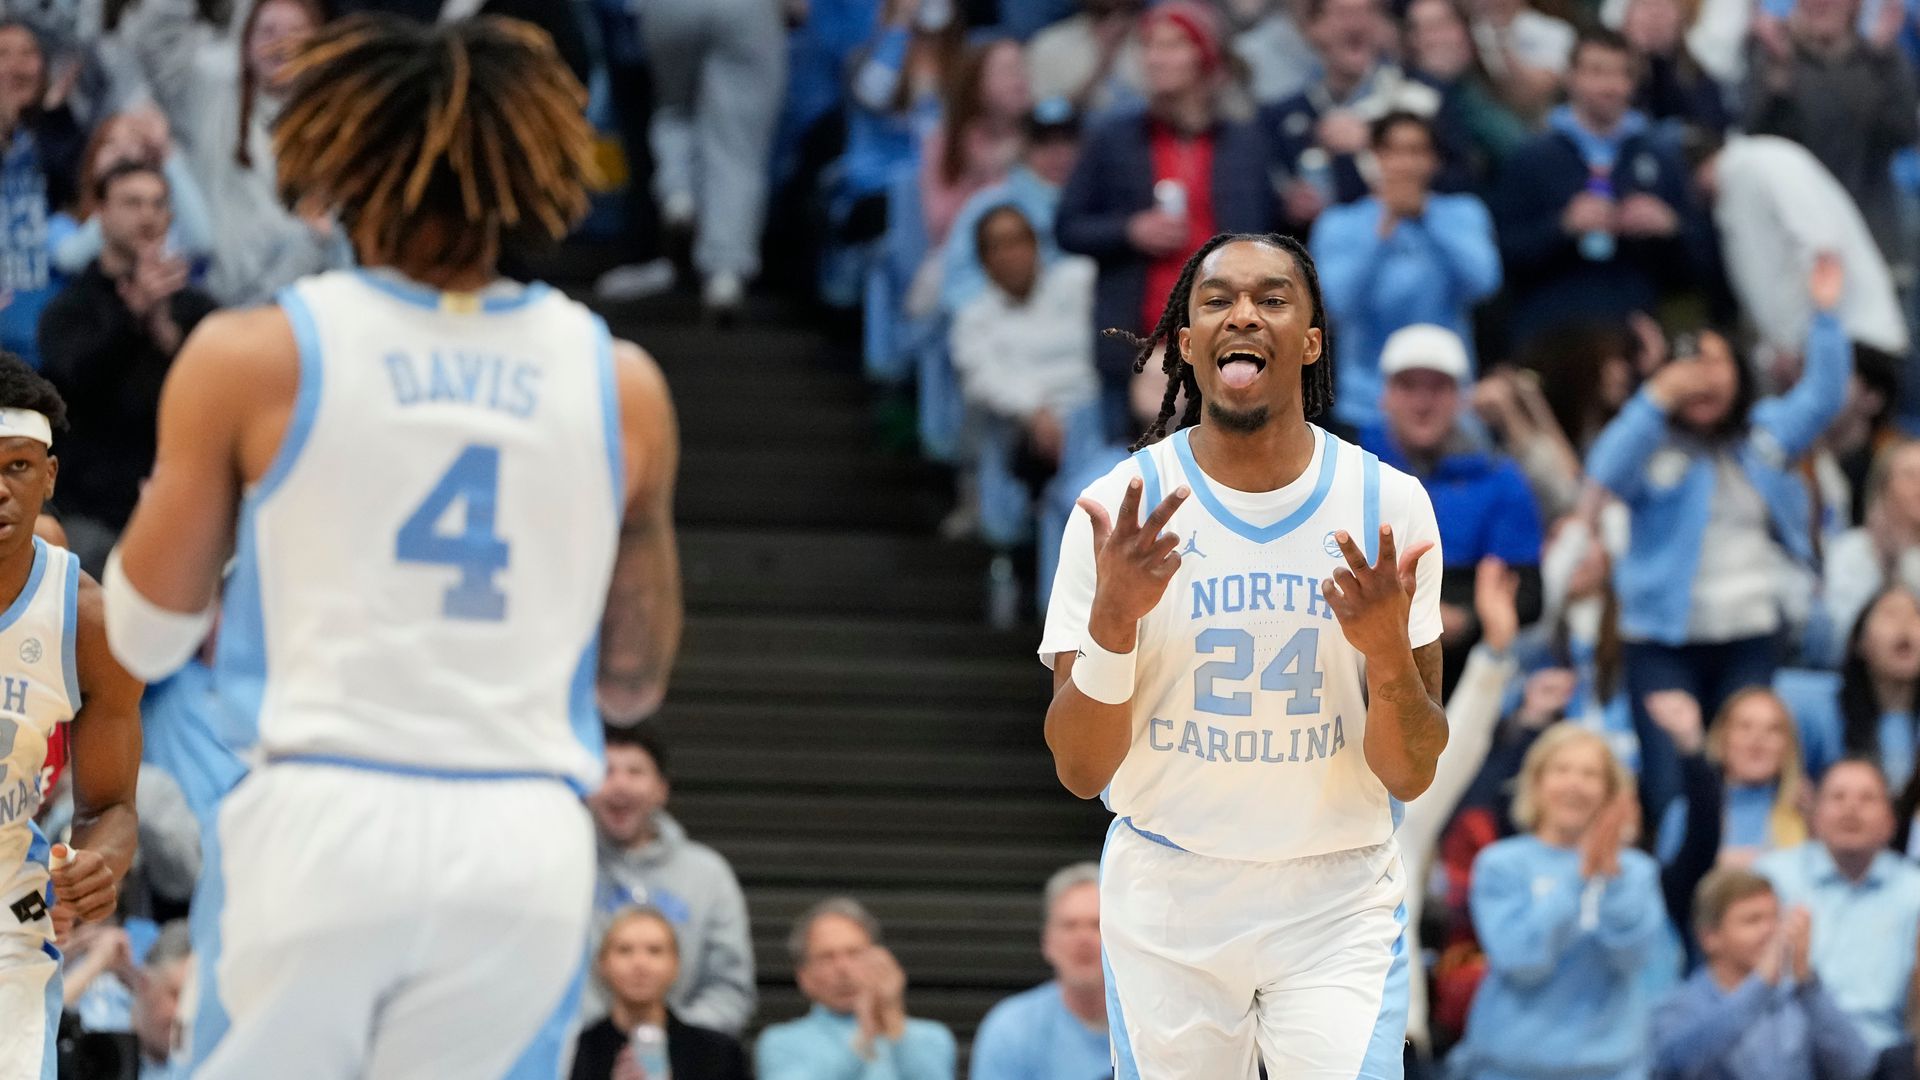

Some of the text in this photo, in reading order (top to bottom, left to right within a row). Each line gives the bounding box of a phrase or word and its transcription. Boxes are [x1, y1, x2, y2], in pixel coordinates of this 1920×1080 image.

[384, 351, 541, 419] DAVIS
[396, 444, 509, 621] 4
[1191, 572, 1333, 620] NORTH
[1194, 627, 1324, 716] 24
[1150, 714, 1347, 763] CAROLINA
